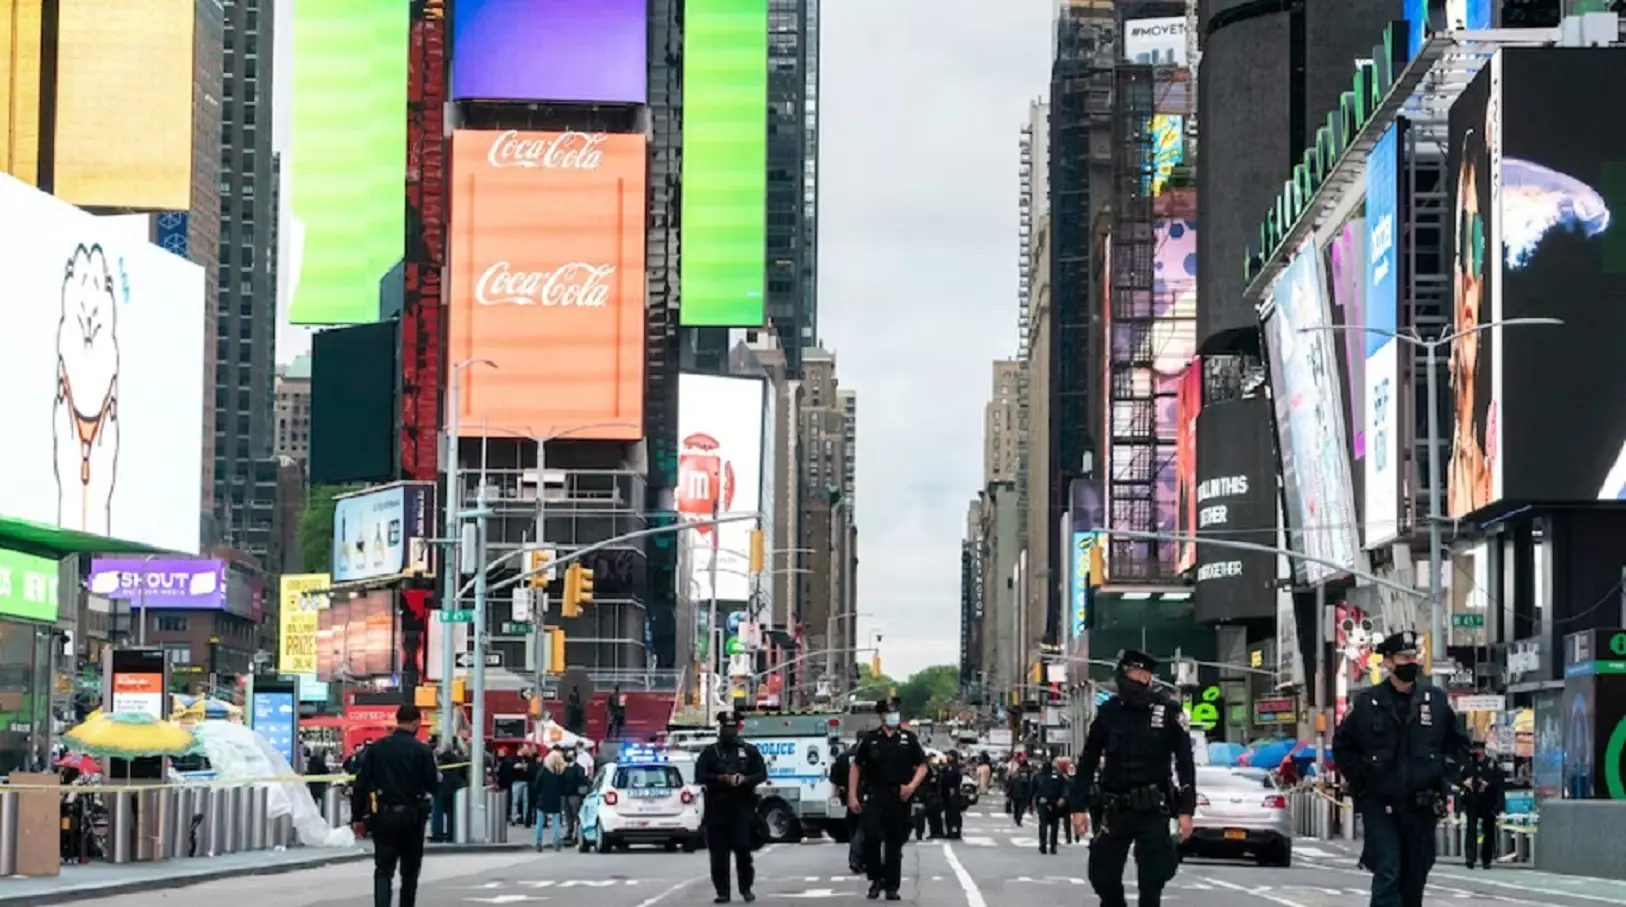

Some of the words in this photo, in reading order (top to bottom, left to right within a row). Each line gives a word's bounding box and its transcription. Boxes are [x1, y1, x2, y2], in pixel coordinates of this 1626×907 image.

[488, 130, 607, 170] Coca-Cola
[475, 261, 617, 307] Coca-Cola
[1221, 475, 1249, 497] THIS
[121, 571, 189, 588] SHOUT
